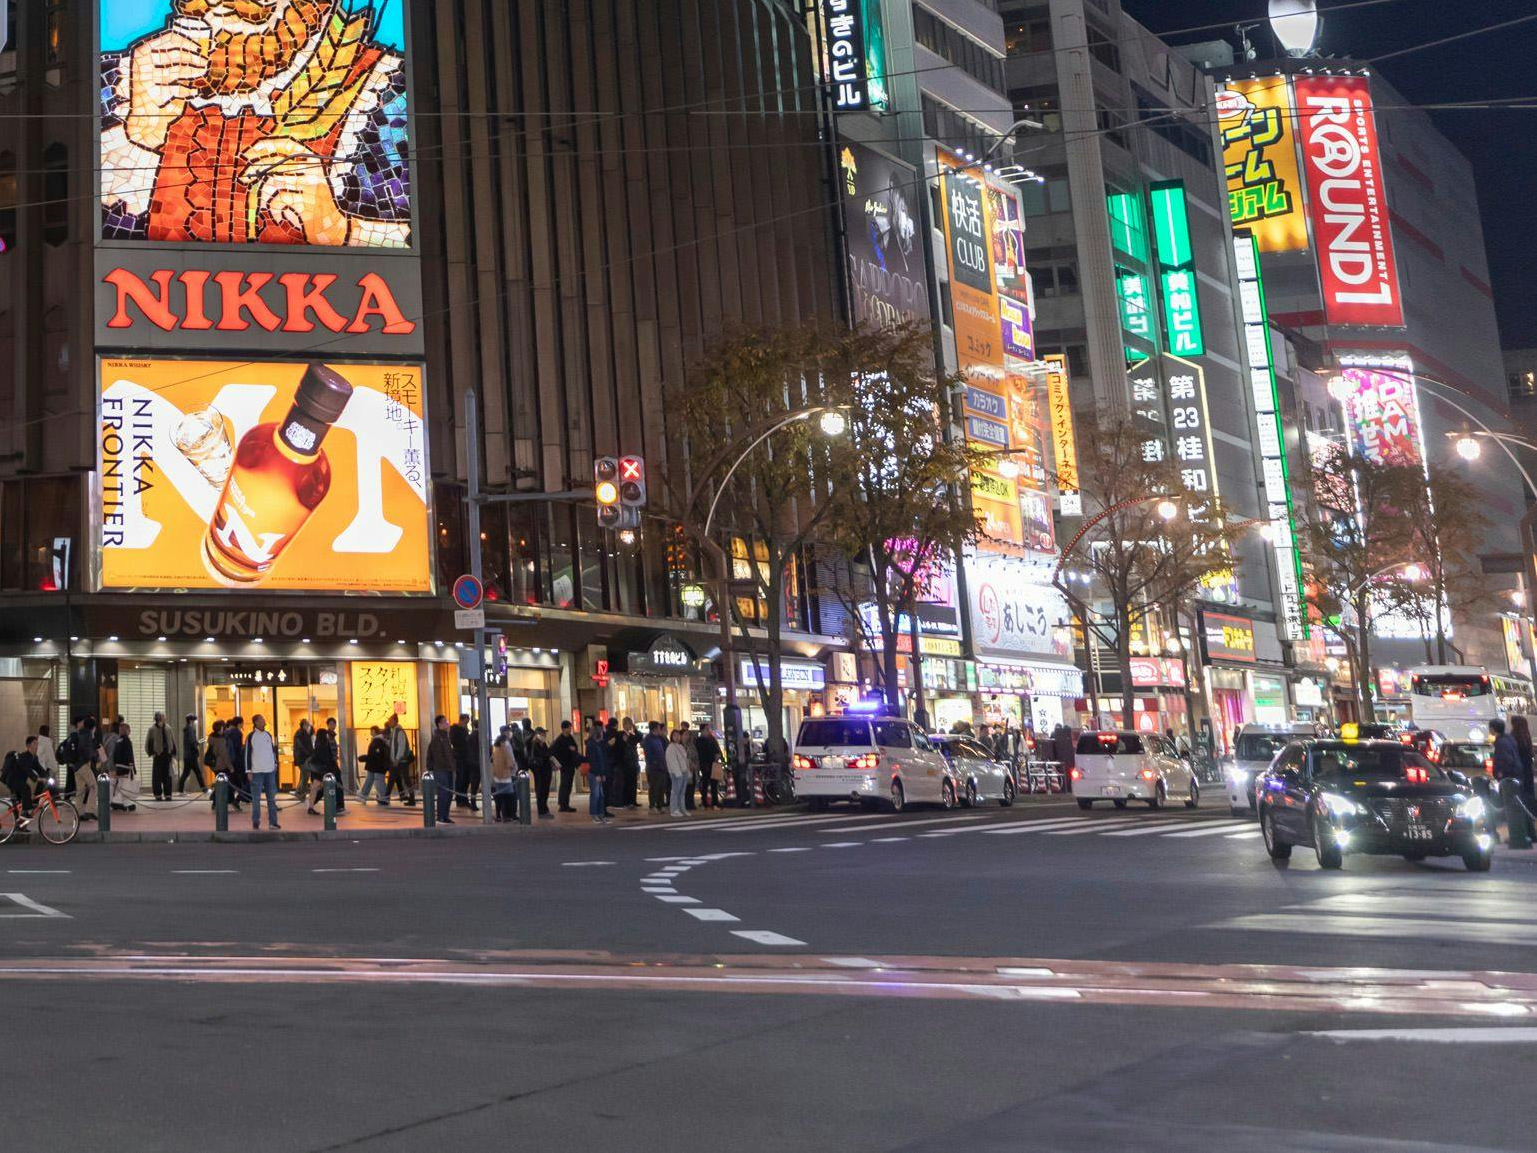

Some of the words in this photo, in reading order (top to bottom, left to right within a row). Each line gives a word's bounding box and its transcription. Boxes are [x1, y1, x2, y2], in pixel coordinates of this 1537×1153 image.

[952, 188, 982, 238] 快活
[1352, 99, 1370, 155] SPORTS
[1363, 160, 1388, 281] ENTERTAINMENT
[956, 236, 986, 273] CLUB
[102, 267, 416, 335] NIKKA
[382, 372, 404, 431] 新境地。
[401, 373, 422, 489] スモーキー薫る、
[102, 397, 124, 547] FRONTIER
[133, 398, 154, 495] NIKKA
[139, 610, 303, 636] SUSUKINO
[317, 613, 387, 637] BLD.
[359, 667, 374, 722] スクエア
